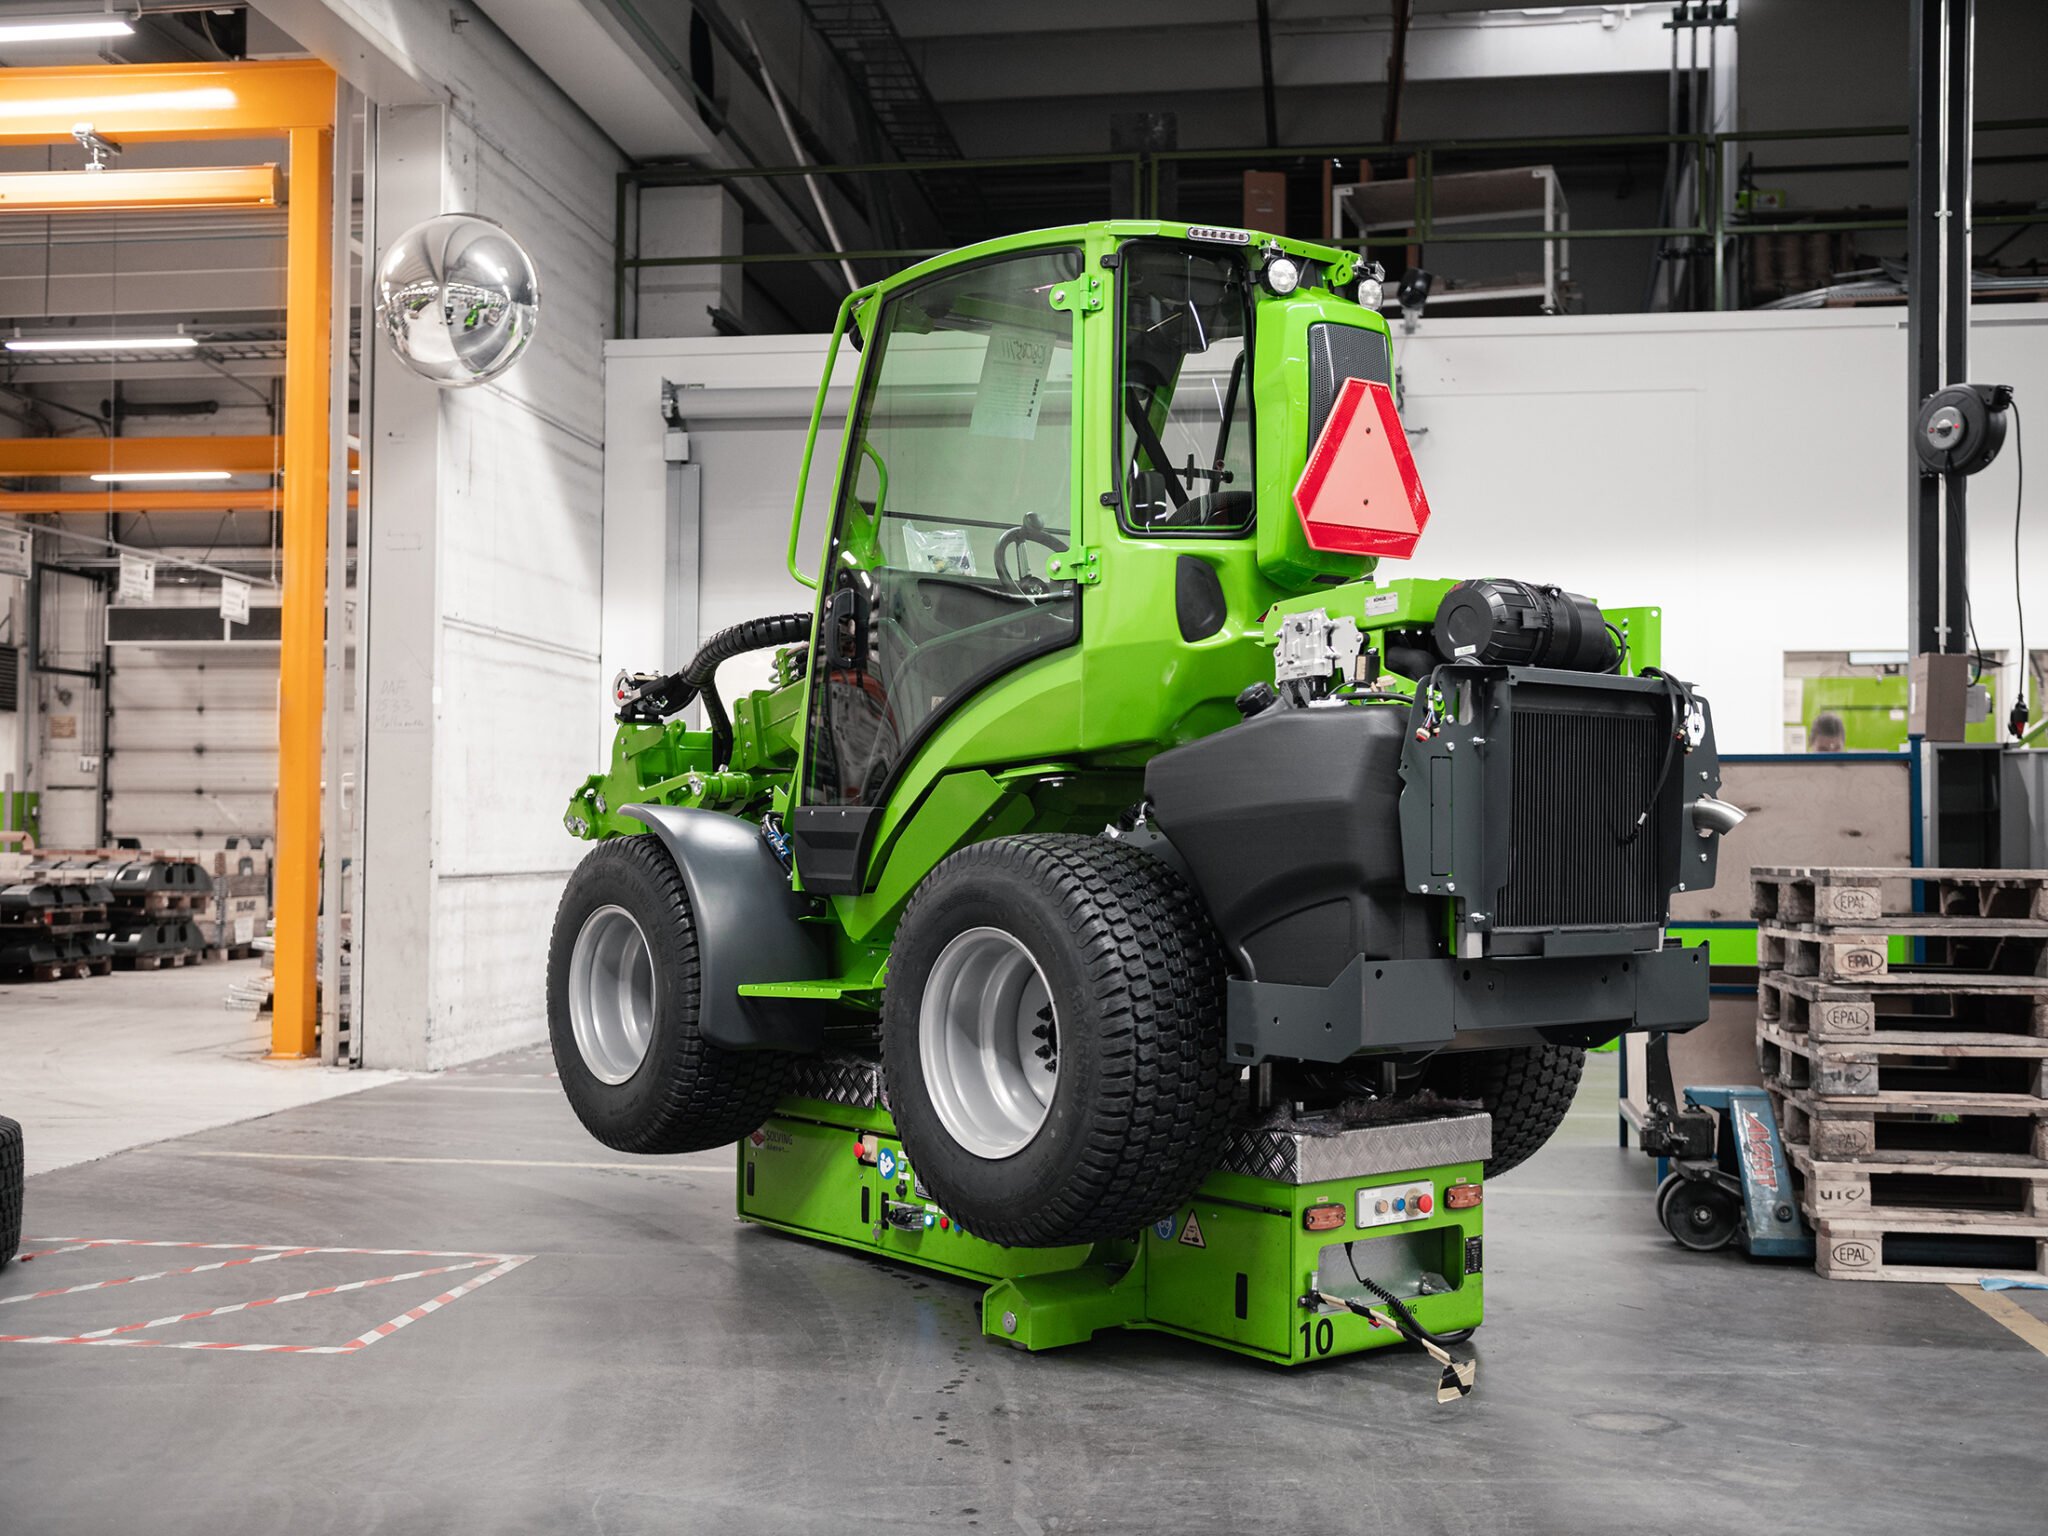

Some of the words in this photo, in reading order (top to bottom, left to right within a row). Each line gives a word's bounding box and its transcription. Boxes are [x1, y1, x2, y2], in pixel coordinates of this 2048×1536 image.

[1833, 1010, 1862, 1024] EPAL
[766, 1129, 793, 1146] SOLVING
[1832, 1133, 1860, 1148] PAL
[1840, 1247, 1869, 1261] EPAL
[1300, 1318, 1333, 1358] 10
